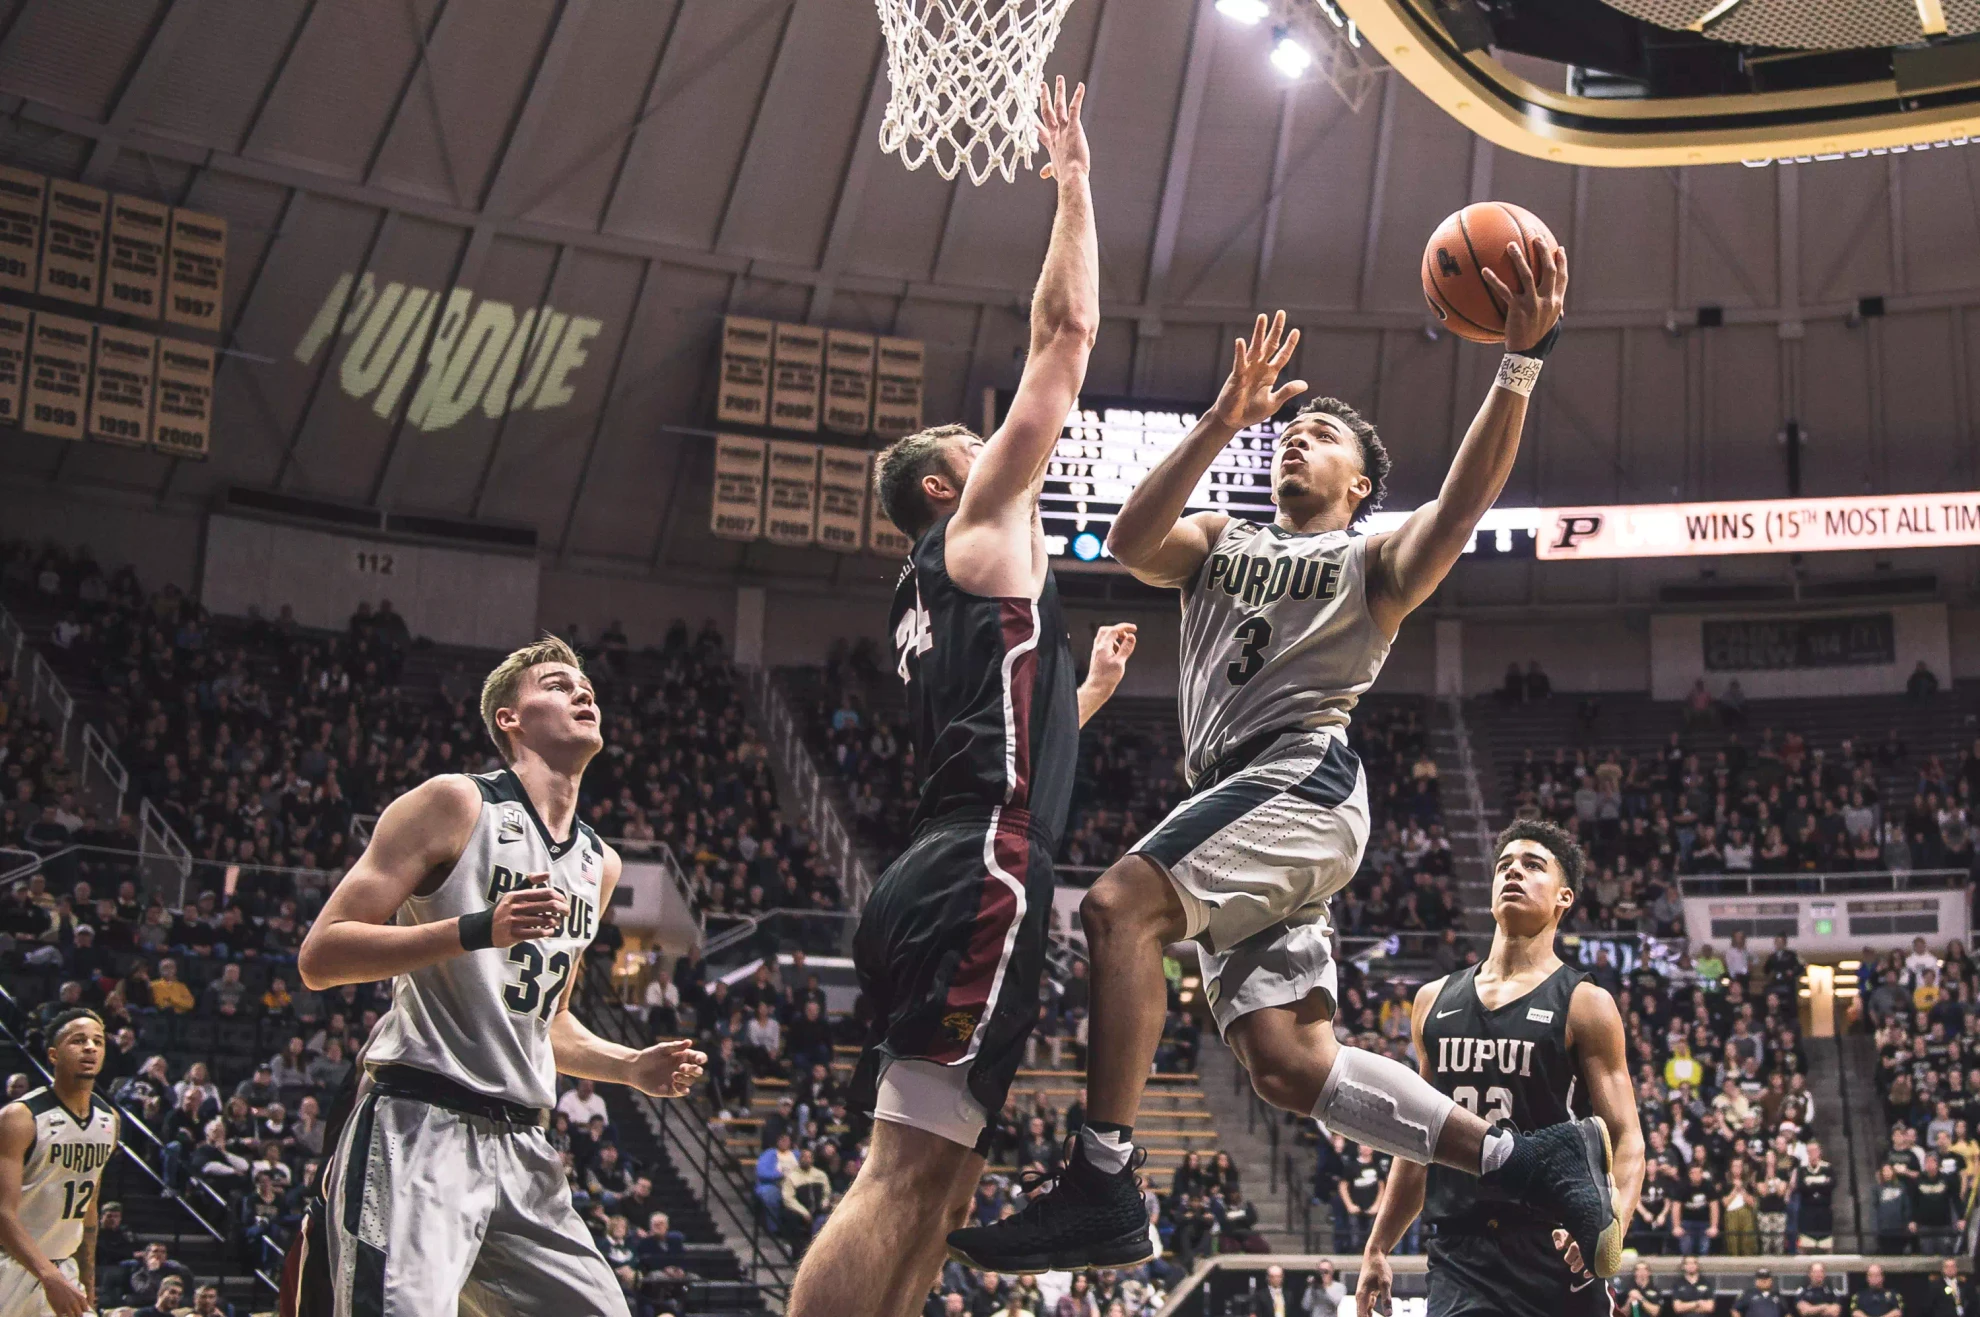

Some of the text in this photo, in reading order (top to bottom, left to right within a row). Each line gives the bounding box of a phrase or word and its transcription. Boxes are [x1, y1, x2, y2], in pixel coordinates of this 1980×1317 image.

[294, 272, 603, 431] PURDUE
[159, 426, 203, 448] 2000
[1686, 513, 1755, 541] WINS
[1765, 508, 1817, 544] (15TH
[1825, 507, 1890, 536] MOST
[1896, 505, 1937, 534] ALL
[356, 551, 393, 575] 112
[1207, 553, 1341, 607] PURDUE
[1226, 616, 1273, 687] 3
[503, 941, 573, 1023] 32
[1437, 1037, 1535, 1077] IUPUI
[62, 1180, 95, 1219] 12
